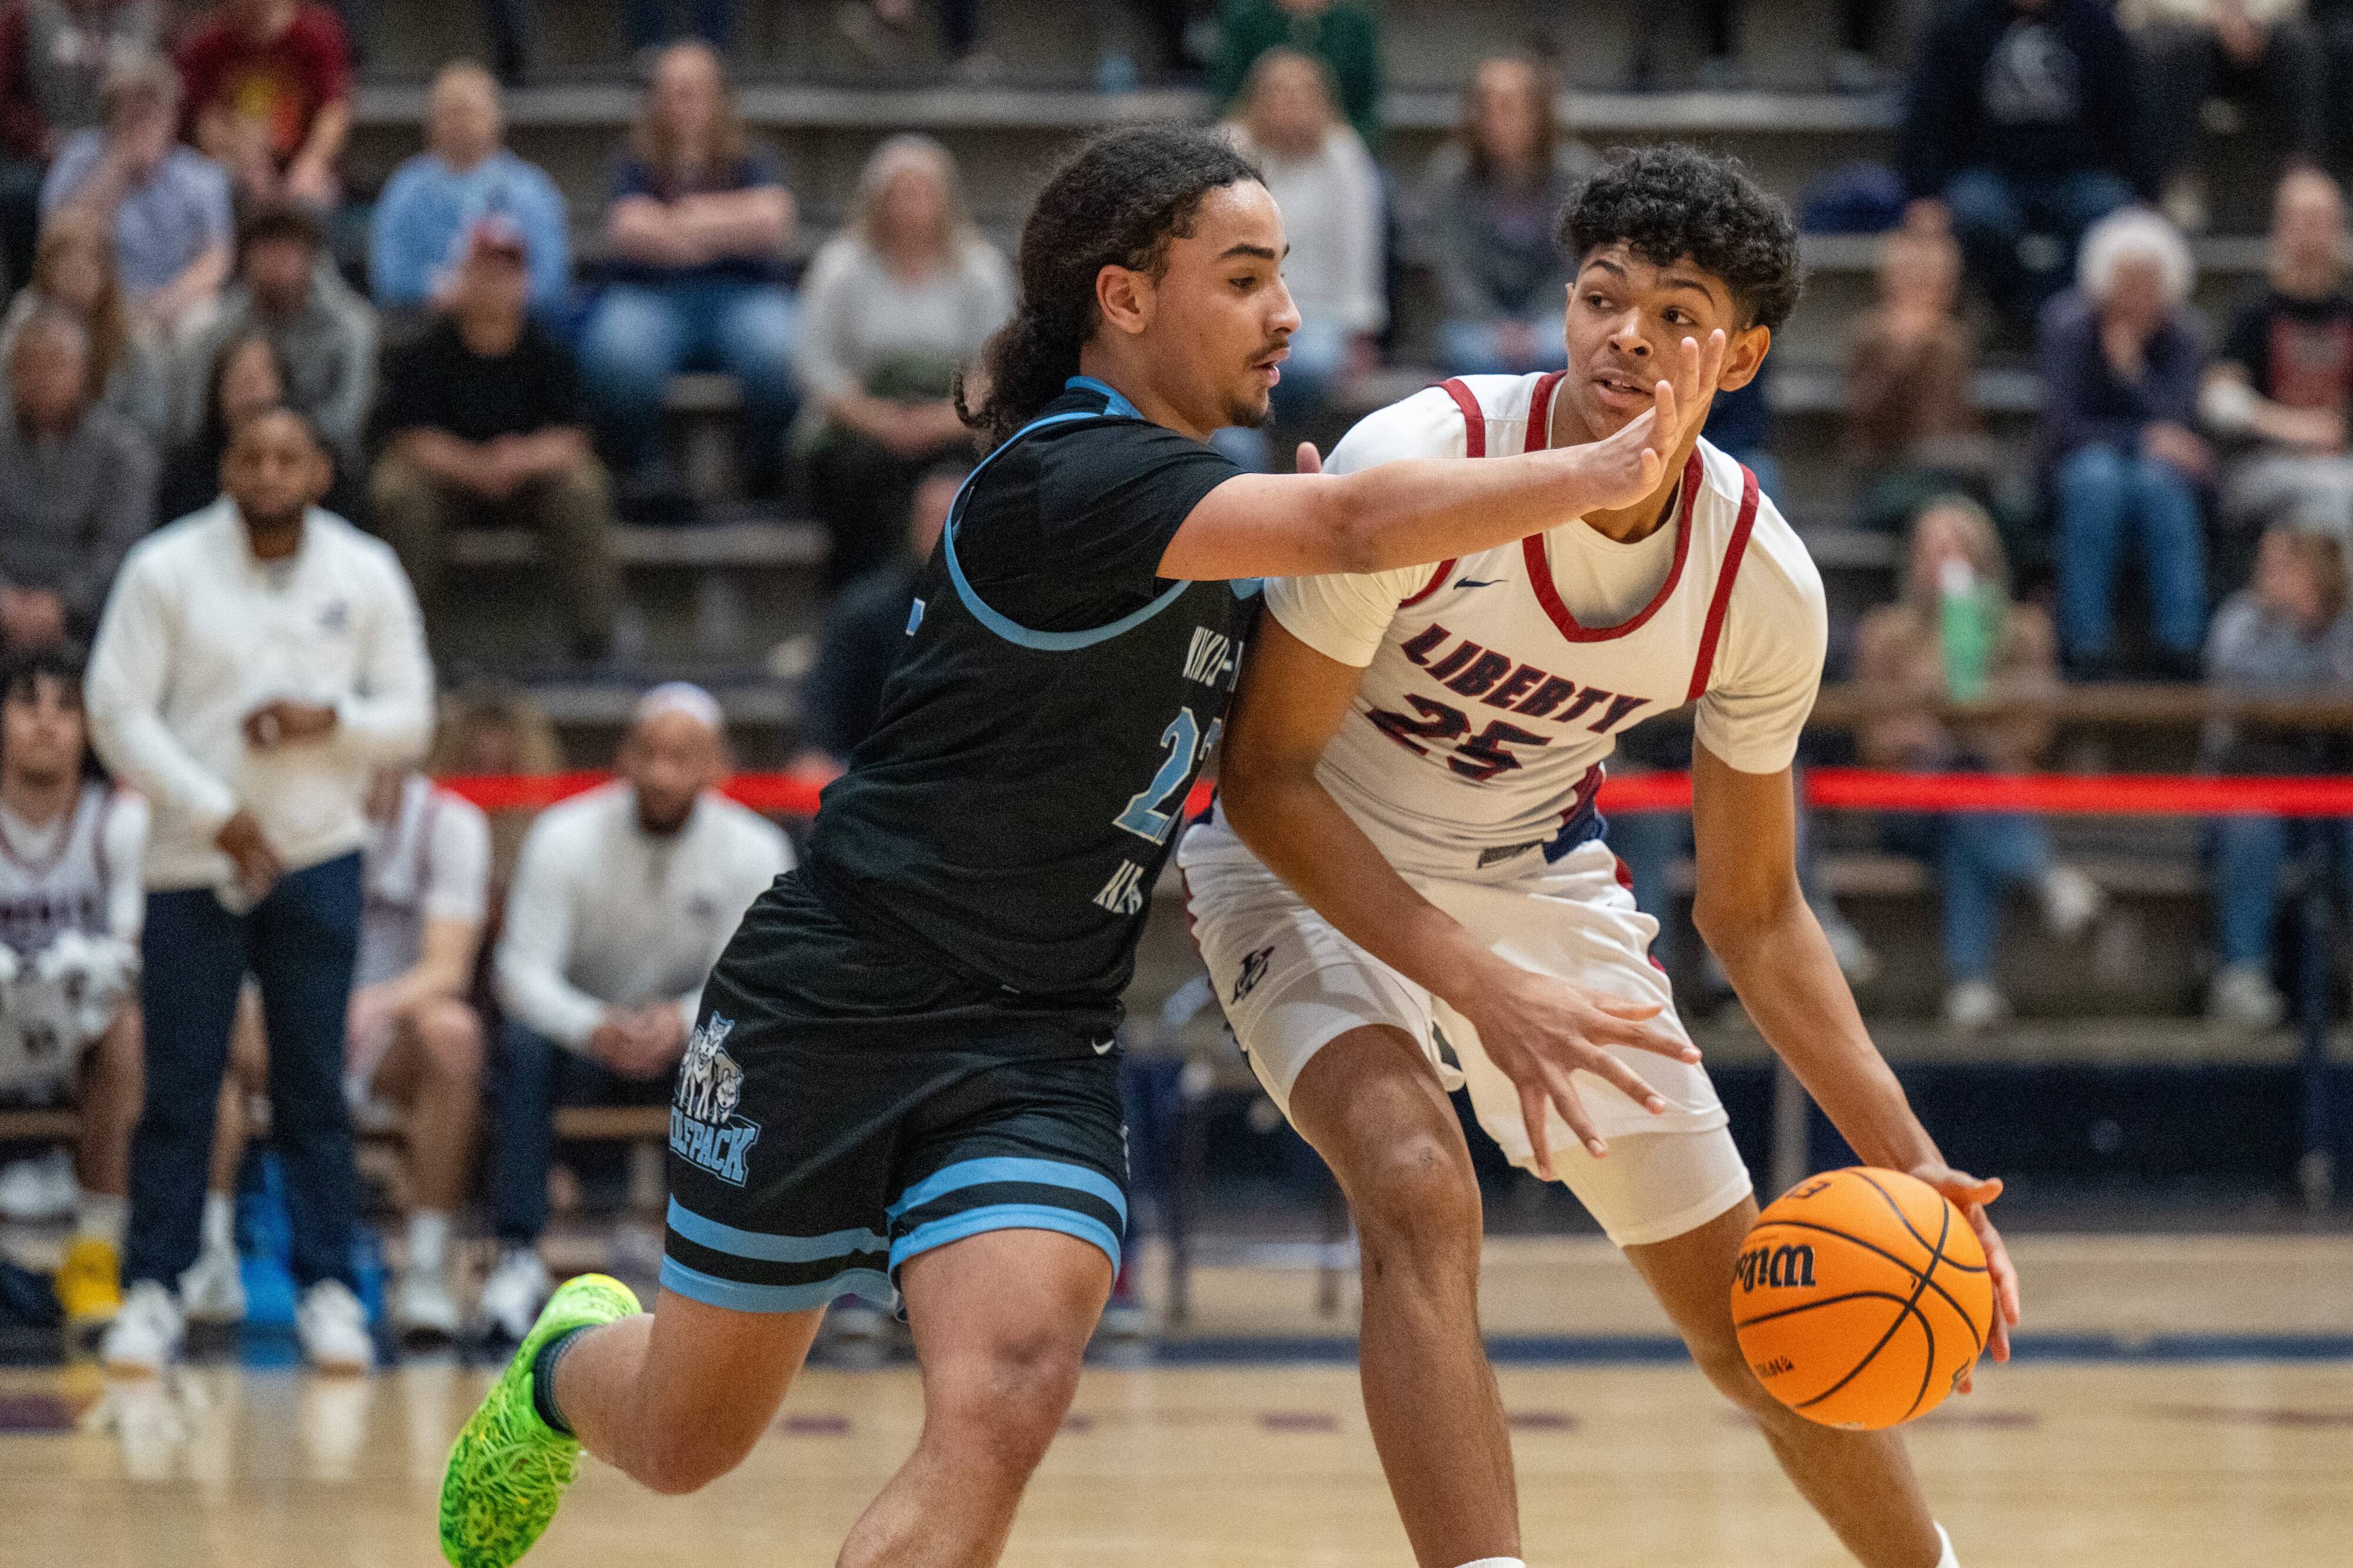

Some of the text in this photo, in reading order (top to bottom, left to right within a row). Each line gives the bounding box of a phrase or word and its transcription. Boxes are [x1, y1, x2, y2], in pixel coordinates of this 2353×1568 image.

[1400, 622, 1652, 735] LIBERTY
[1365, 693, 1554, 782] 25
[669, 1105, 759, 1182] OLFPACK
